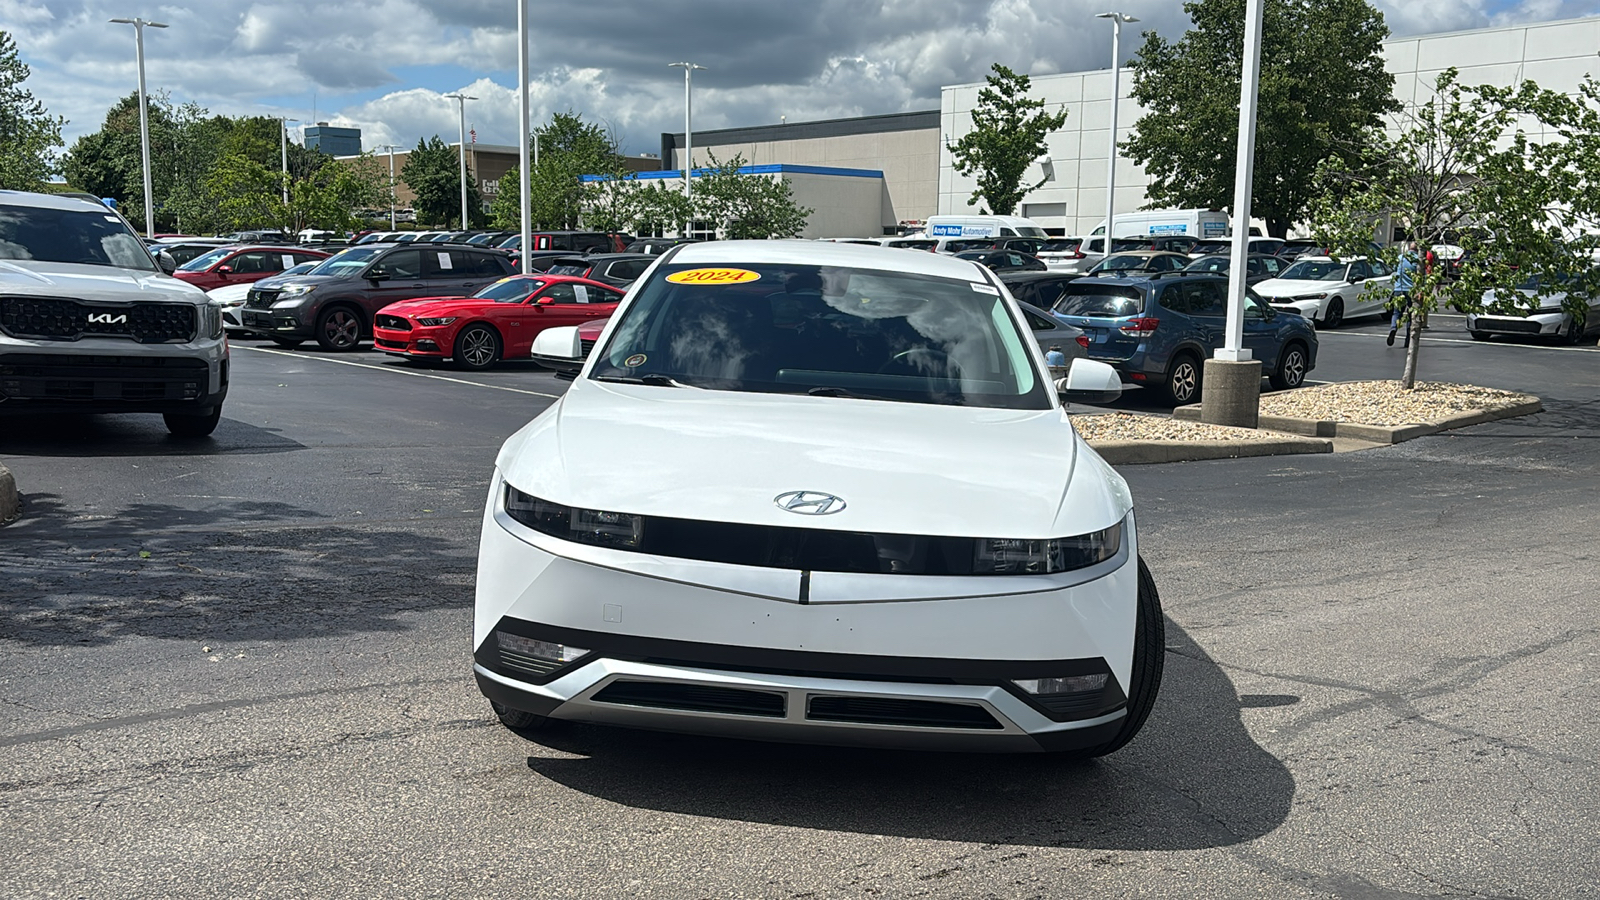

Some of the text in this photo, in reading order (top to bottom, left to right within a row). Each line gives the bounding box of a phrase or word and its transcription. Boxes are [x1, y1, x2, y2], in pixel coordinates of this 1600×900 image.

[933, 226, 992, 236] Andy Mohr Automotive
[680, 271, 747, 282] 2024
[88, 313, 127, 324] KIA
